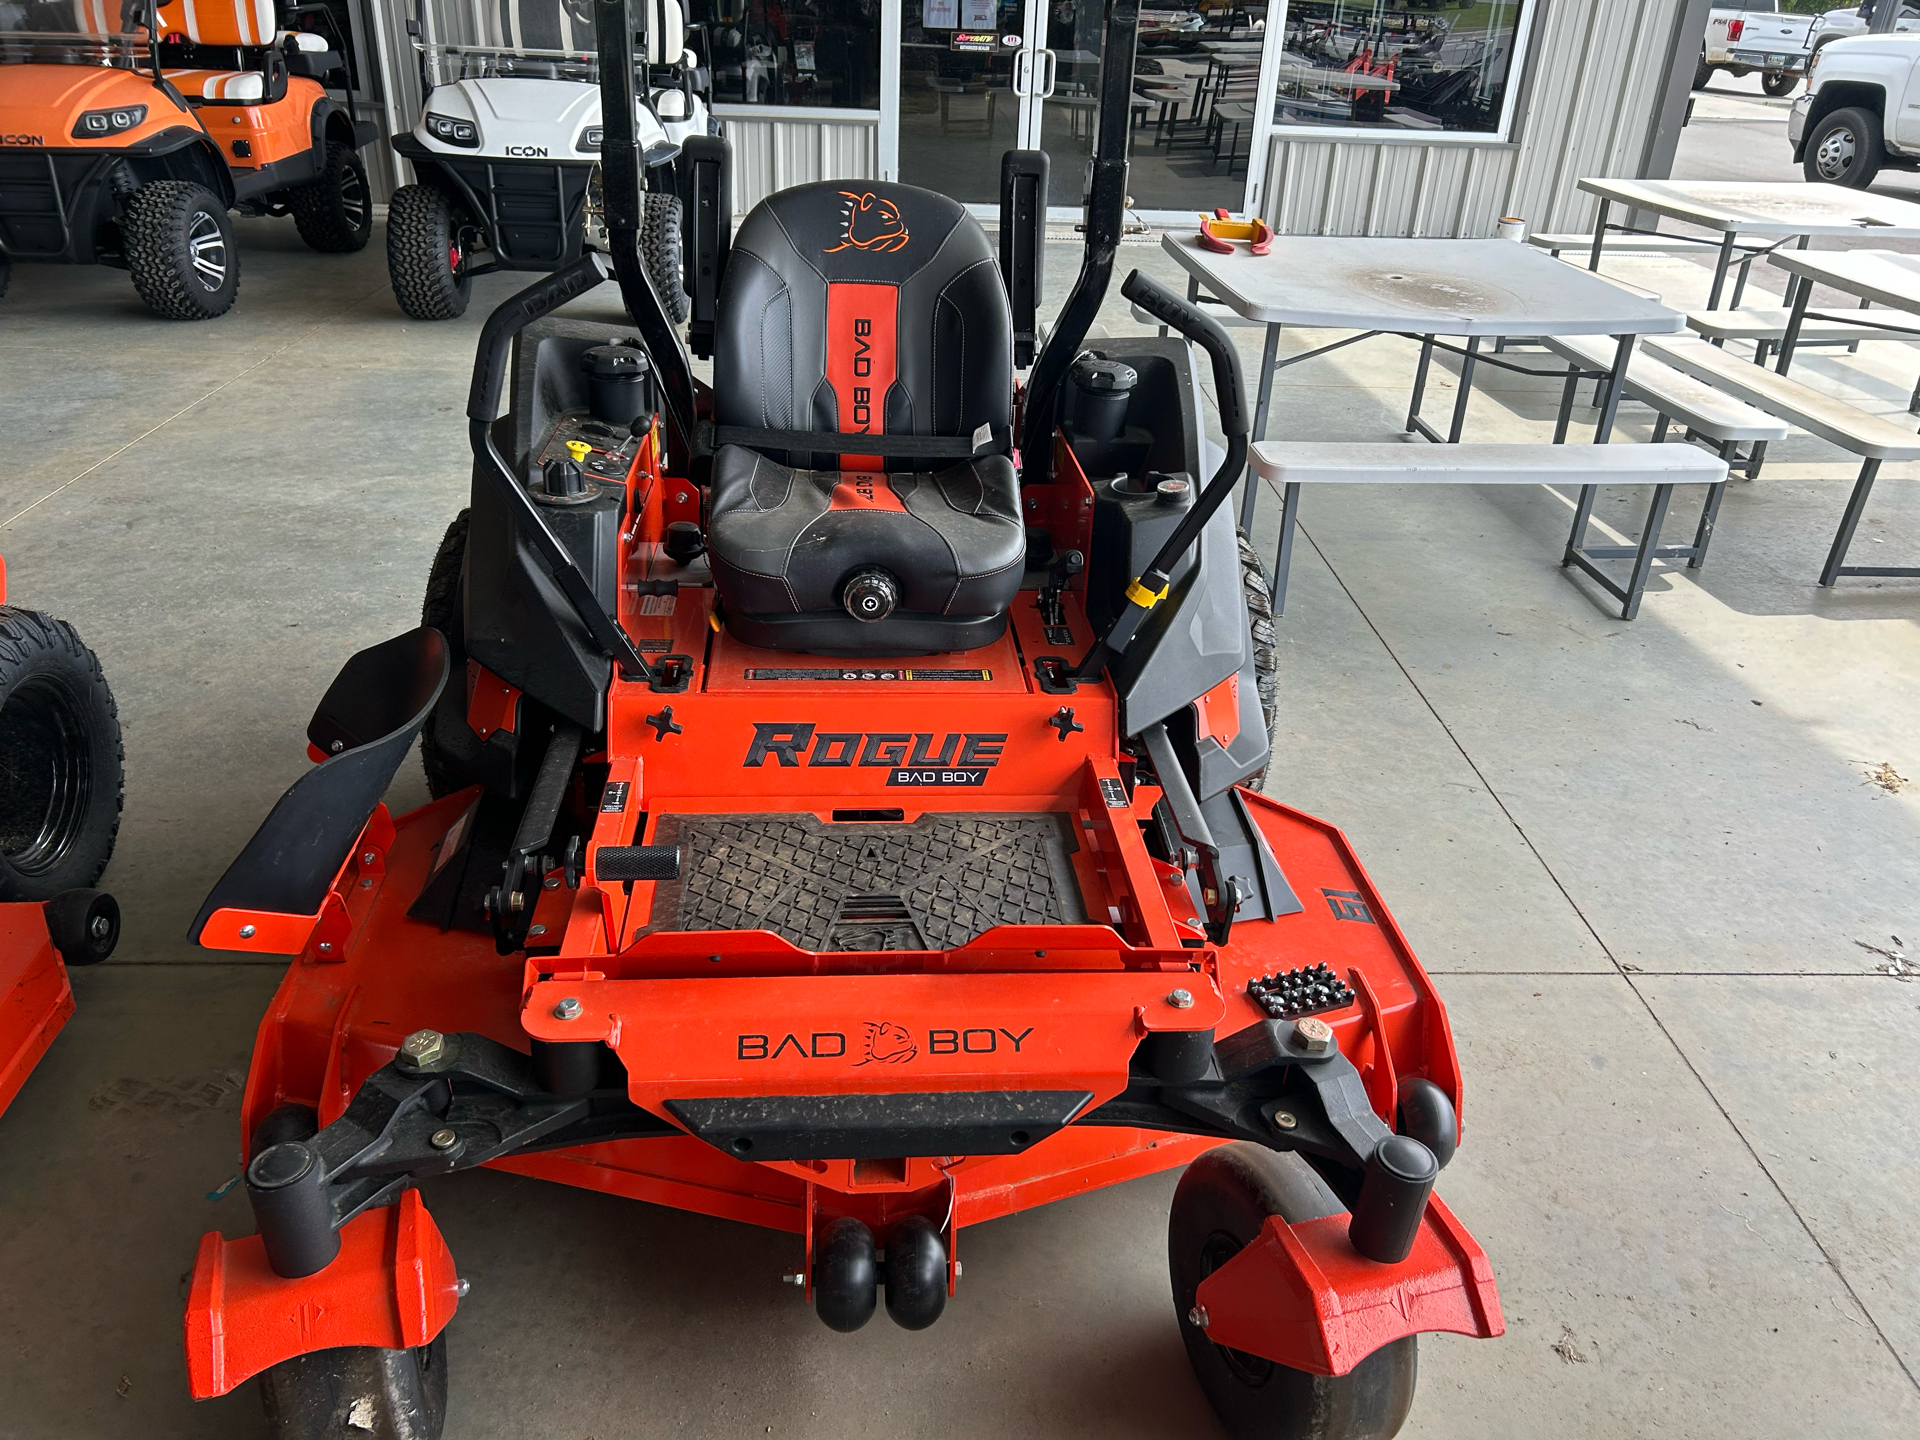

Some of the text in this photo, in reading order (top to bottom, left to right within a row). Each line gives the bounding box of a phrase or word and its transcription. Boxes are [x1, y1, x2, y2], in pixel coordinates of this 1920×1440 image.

[1713, 18, 1728, 26] FX4
[0, 134, 44, 146] ICON
[505, 146, 548, 157] ICON
[521, 269, 588, 316] BAD
[1135, 284, 1202, 328] BOY
[854, 319, 871, 377] BAD
[743, 723, 1009, 767] ROGUE
[898, 772, 980, 783] BAD BOY
[738, 1027, 1034, 1060] BAD BOY
